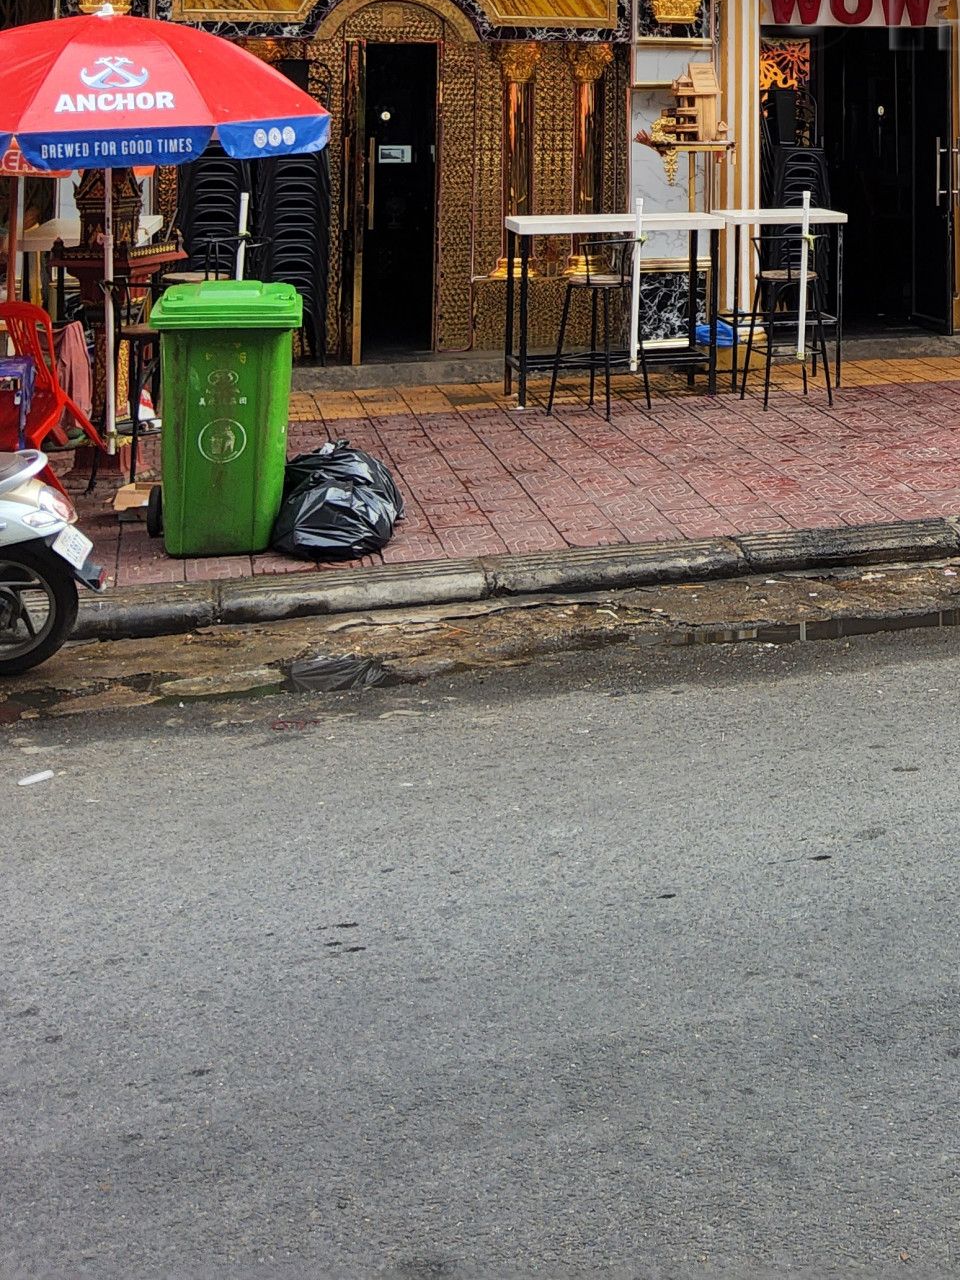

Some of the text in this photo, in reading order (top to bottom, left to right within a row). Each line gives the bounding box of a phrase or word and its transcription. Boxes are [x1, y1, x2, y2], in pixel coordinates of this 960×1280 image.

[54, 90, 175, 113] ANCHOR
[41, 137, 193, 160] BREWED FOR GOOD TIMES
